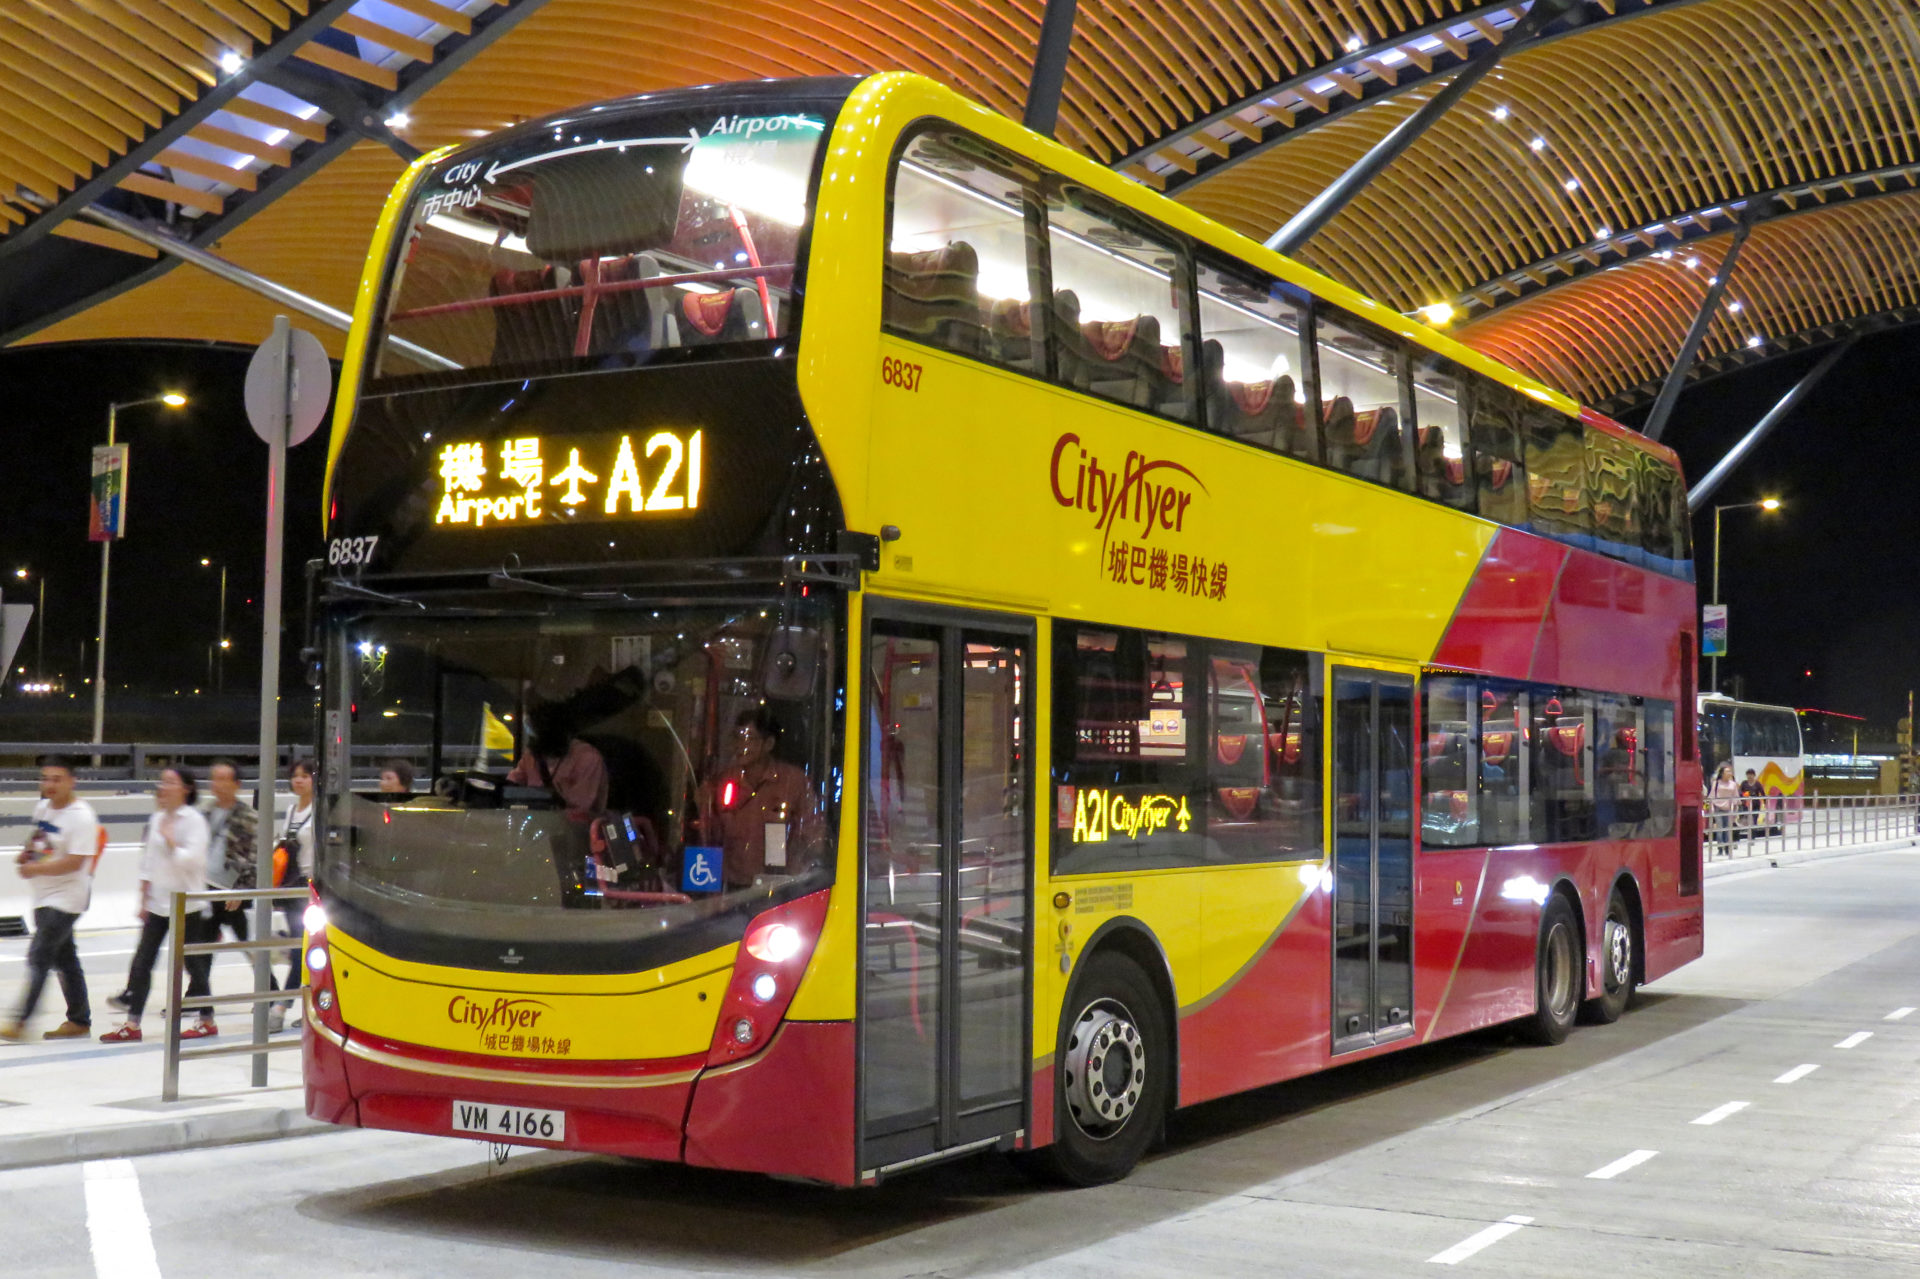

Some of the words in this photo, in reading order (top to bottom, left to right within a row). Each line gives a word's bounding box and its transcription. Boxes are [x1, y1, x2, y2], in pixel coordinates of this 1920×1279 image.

[708, 112, 807, 139] Airport
[444, 161, 483, 184] City
[421, 184, 481, 216] 市中心
[882, 356, 923, 393] 6837
[439, 437, 544, 493] 機場
[604, 430, 701, 514] A21
[1050, 432, 1192, 540] Cityflyer
[435, 485, 542, 527] Airport
[328, 535, 379, 565] 6837
[1107, 540, 1229, 602] 城巴機場快線
[1073, 789, 1109, 843] A21
[448, 995, 542, 1032] Cityflyer
[484, 1033, 572, 1056] 城巴機場快線
[460, 1105, 488, 1130] VM
[498, 1109, 554, 1138] 4166
